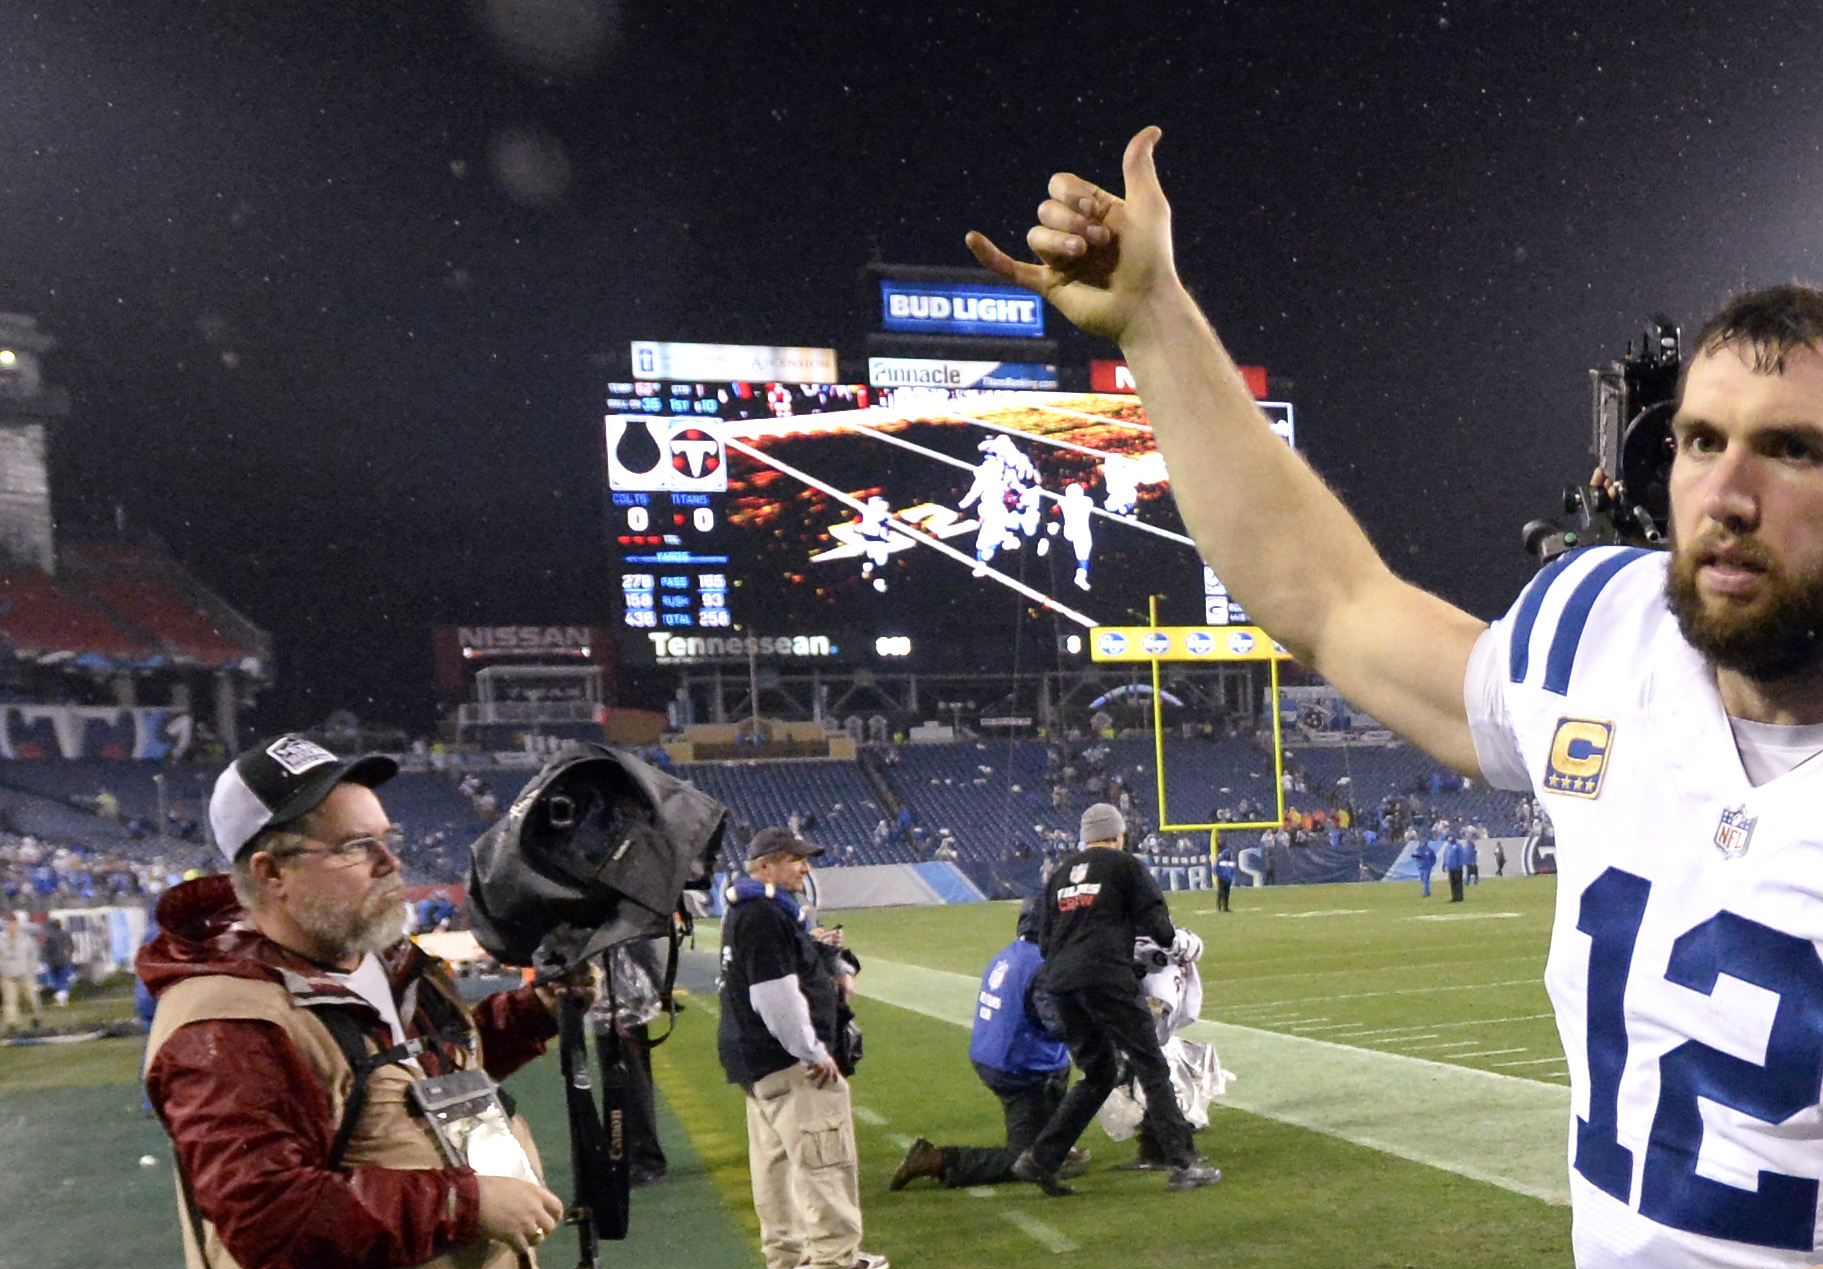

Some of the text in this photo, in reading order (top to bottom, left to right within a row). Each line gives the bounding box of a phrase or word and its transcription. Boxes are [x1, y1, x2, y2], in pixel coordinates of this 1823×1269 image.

[890, 294, 1036, 323] BUD LIGHT
[874, 362, 961, 384] Pinnacle
[612, 493, 650, 506] COLTS
[671, 494, 710, 506] TITANS
[627, 507, 649, 531] 0
[693, 508, 715, 532] 0
[702, 592, 724, 608] 93
[661, 613, 693, 626] TOTAL
[457, 626, 590, 646] NISSAN
[1551, 721, 1609, 777] C
[1717, 826, 1744, 850] NFL
